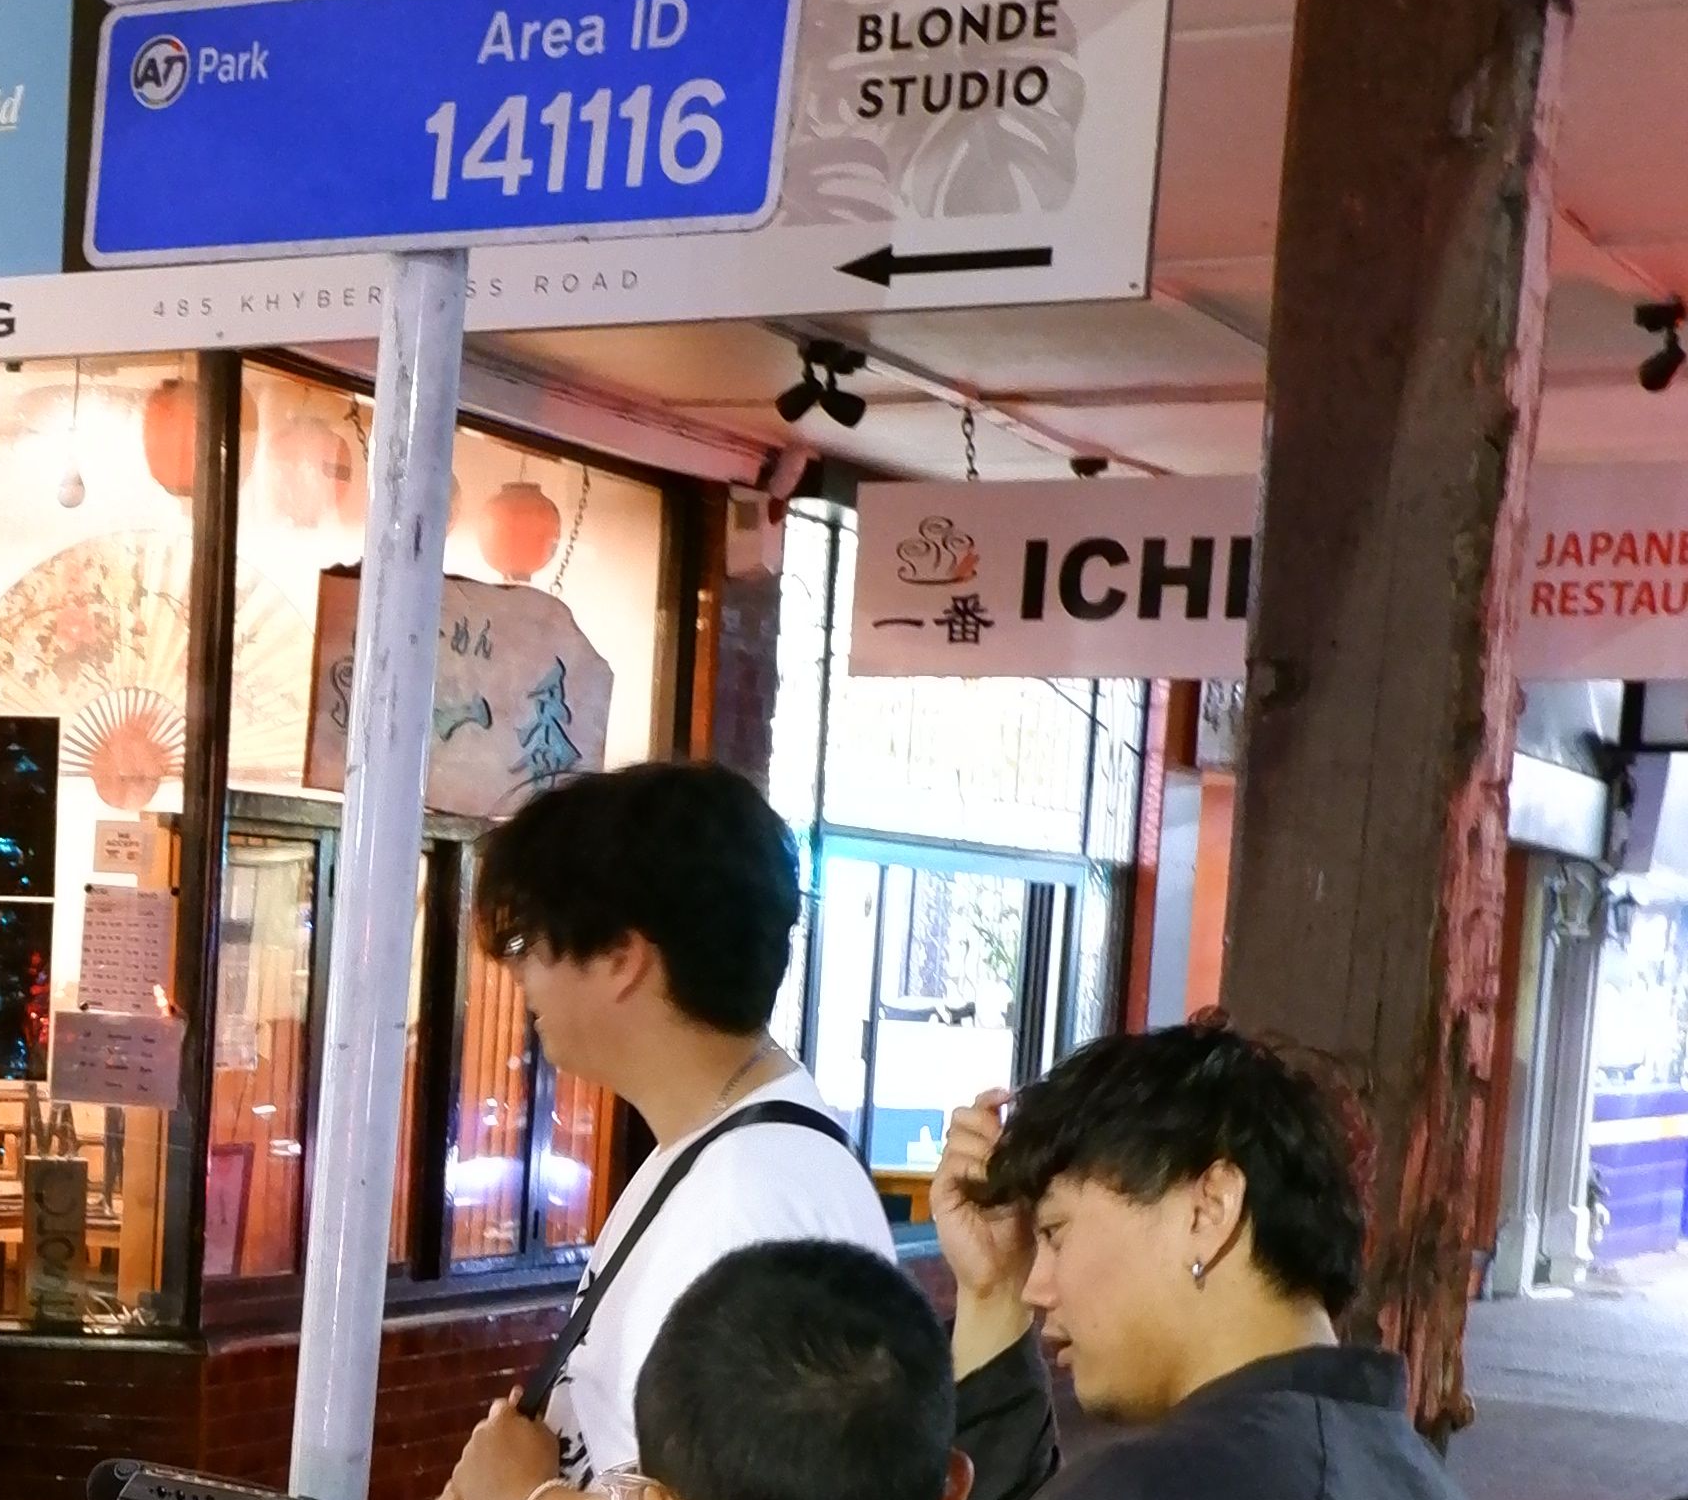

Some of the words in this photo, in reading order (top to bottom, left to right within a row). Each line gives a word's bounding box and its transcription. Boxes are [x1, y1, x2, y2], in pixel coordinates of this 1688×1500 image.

[196, 40, 270, 85] Park
[477, 11, 606, 65] Area
[855, 64, 1051, 119] STUDIO
[424, 78, 727, 201] 141116
[153, 298, 214, 317] 485
[239, 285, 382, 313] KHYBER
[533, 269, 640, 295] ROAD
[872, 593, 995, 645] 一番
